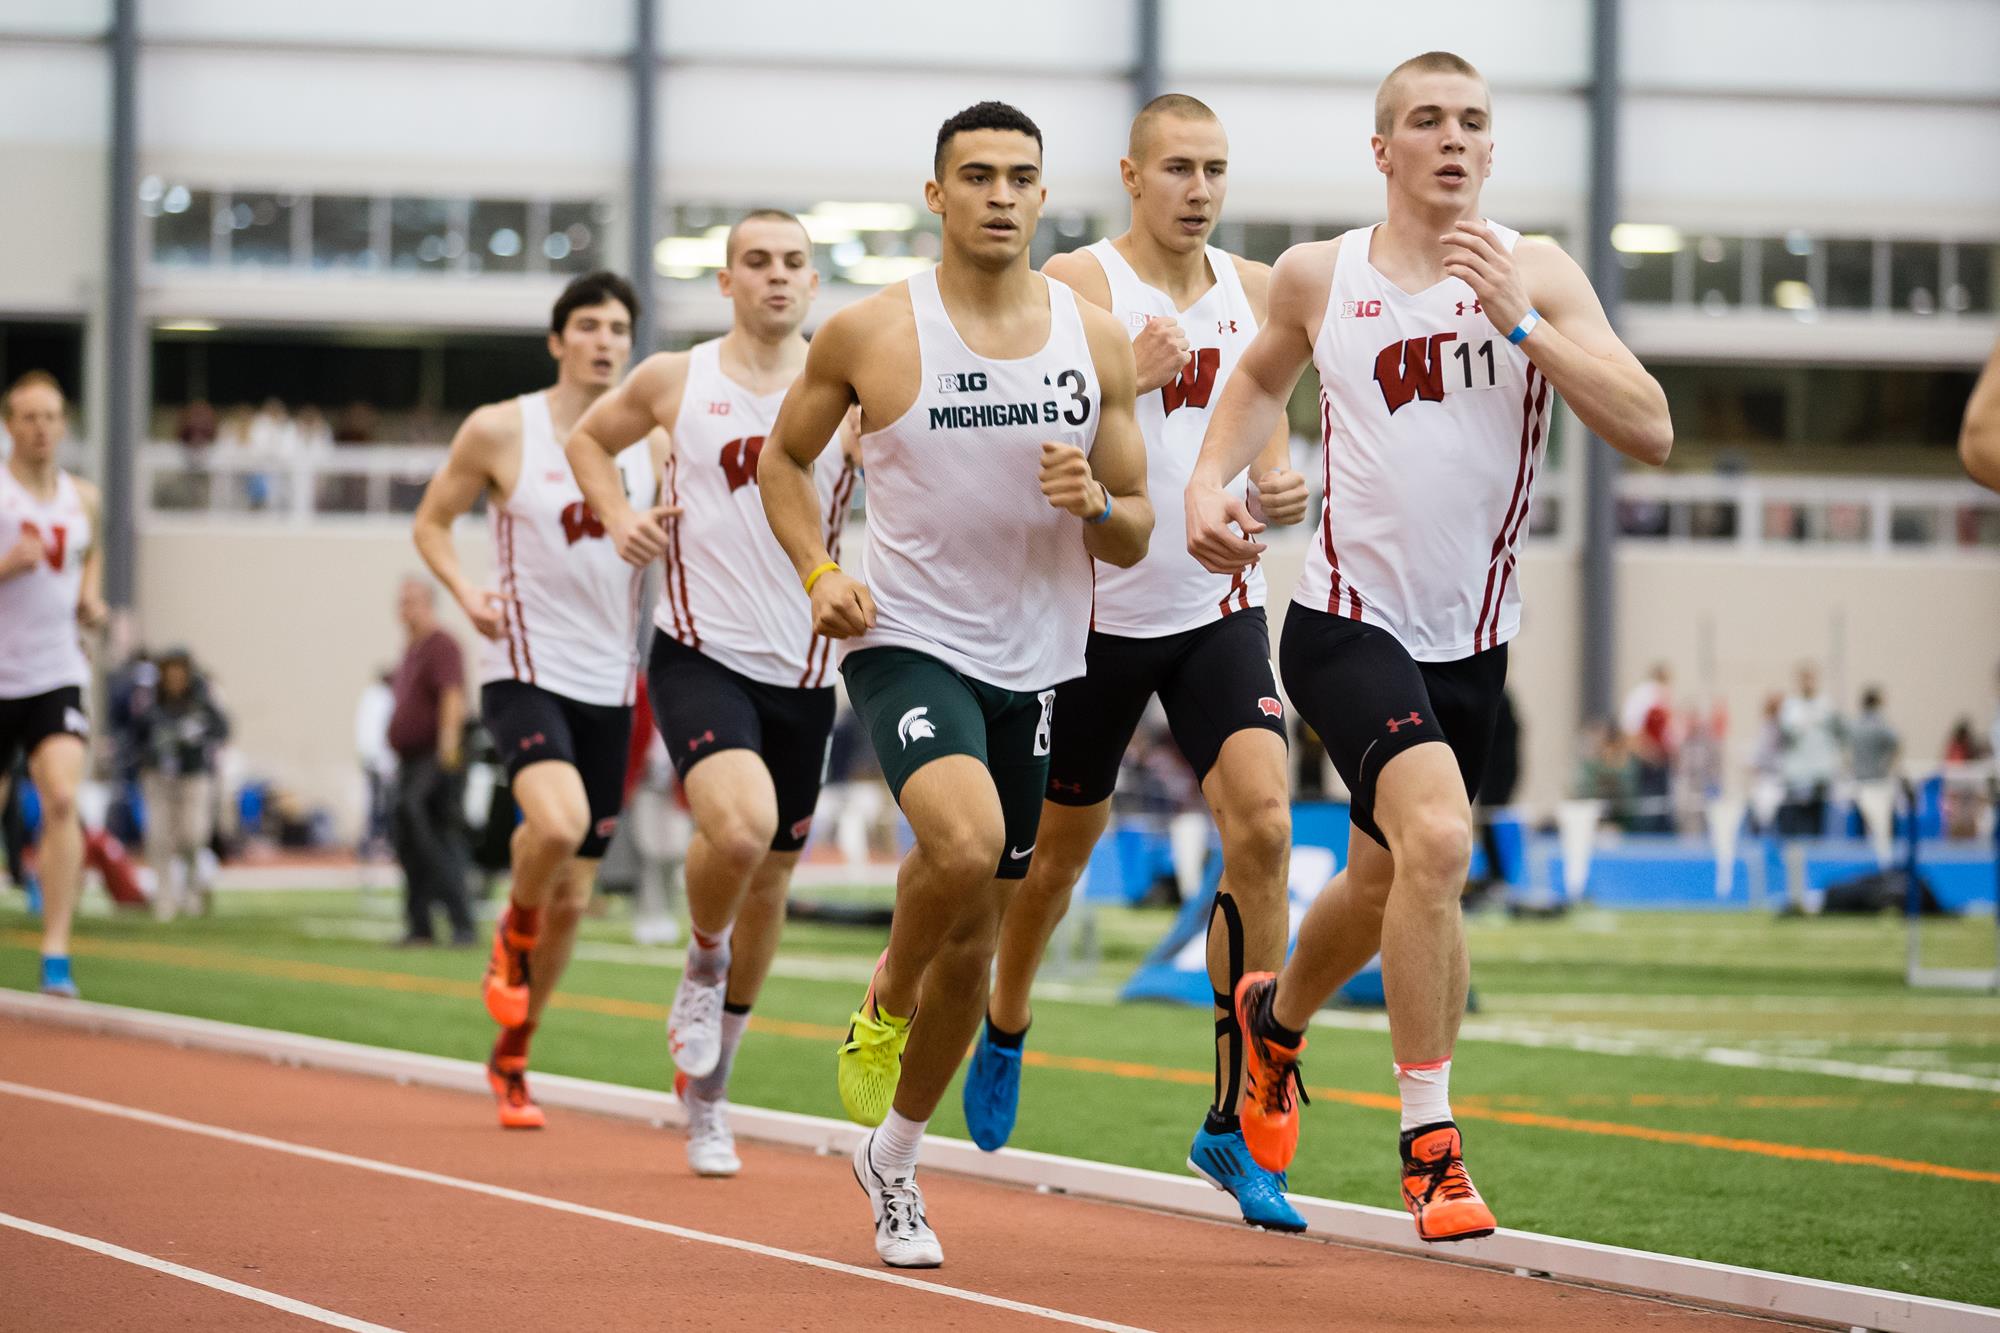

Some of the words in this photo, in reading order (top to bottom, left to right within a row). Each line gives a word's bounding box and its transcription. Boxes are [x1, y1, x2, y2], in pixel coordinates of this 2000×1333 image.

[1373, 331, 1458, 416] W
[1453, 339, 1496, 389] 11
[928, 402, 1039, 430] MICHIGAN
[1056, 368, 1092, 427] 3
